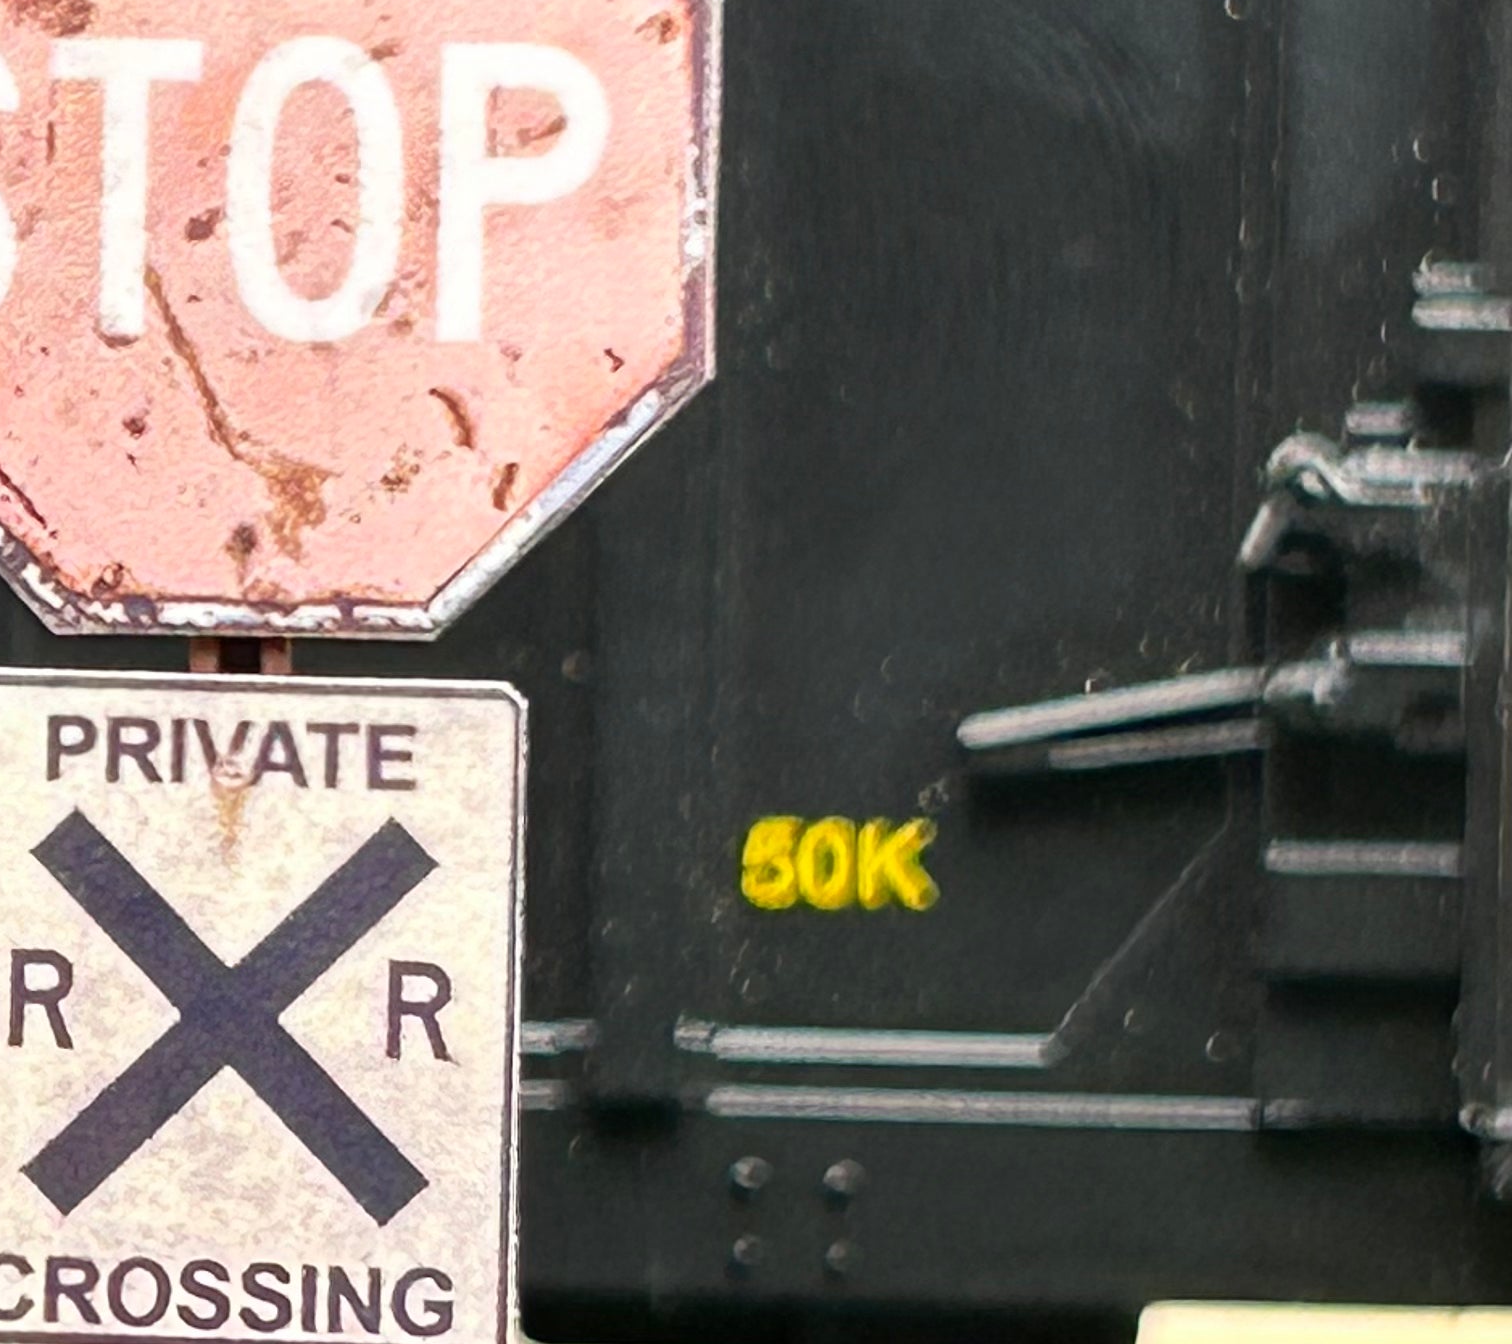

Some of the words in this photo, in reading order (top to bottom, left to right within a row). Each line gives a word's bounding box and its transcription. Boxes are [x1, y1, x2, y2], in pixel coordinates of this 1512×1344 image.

[46, 714, 418, 792] PRIVATE
[741, 815, 940, 912] 50K
[8, 948, 74, 1050] R
[386, 959, 460, 1066] R
